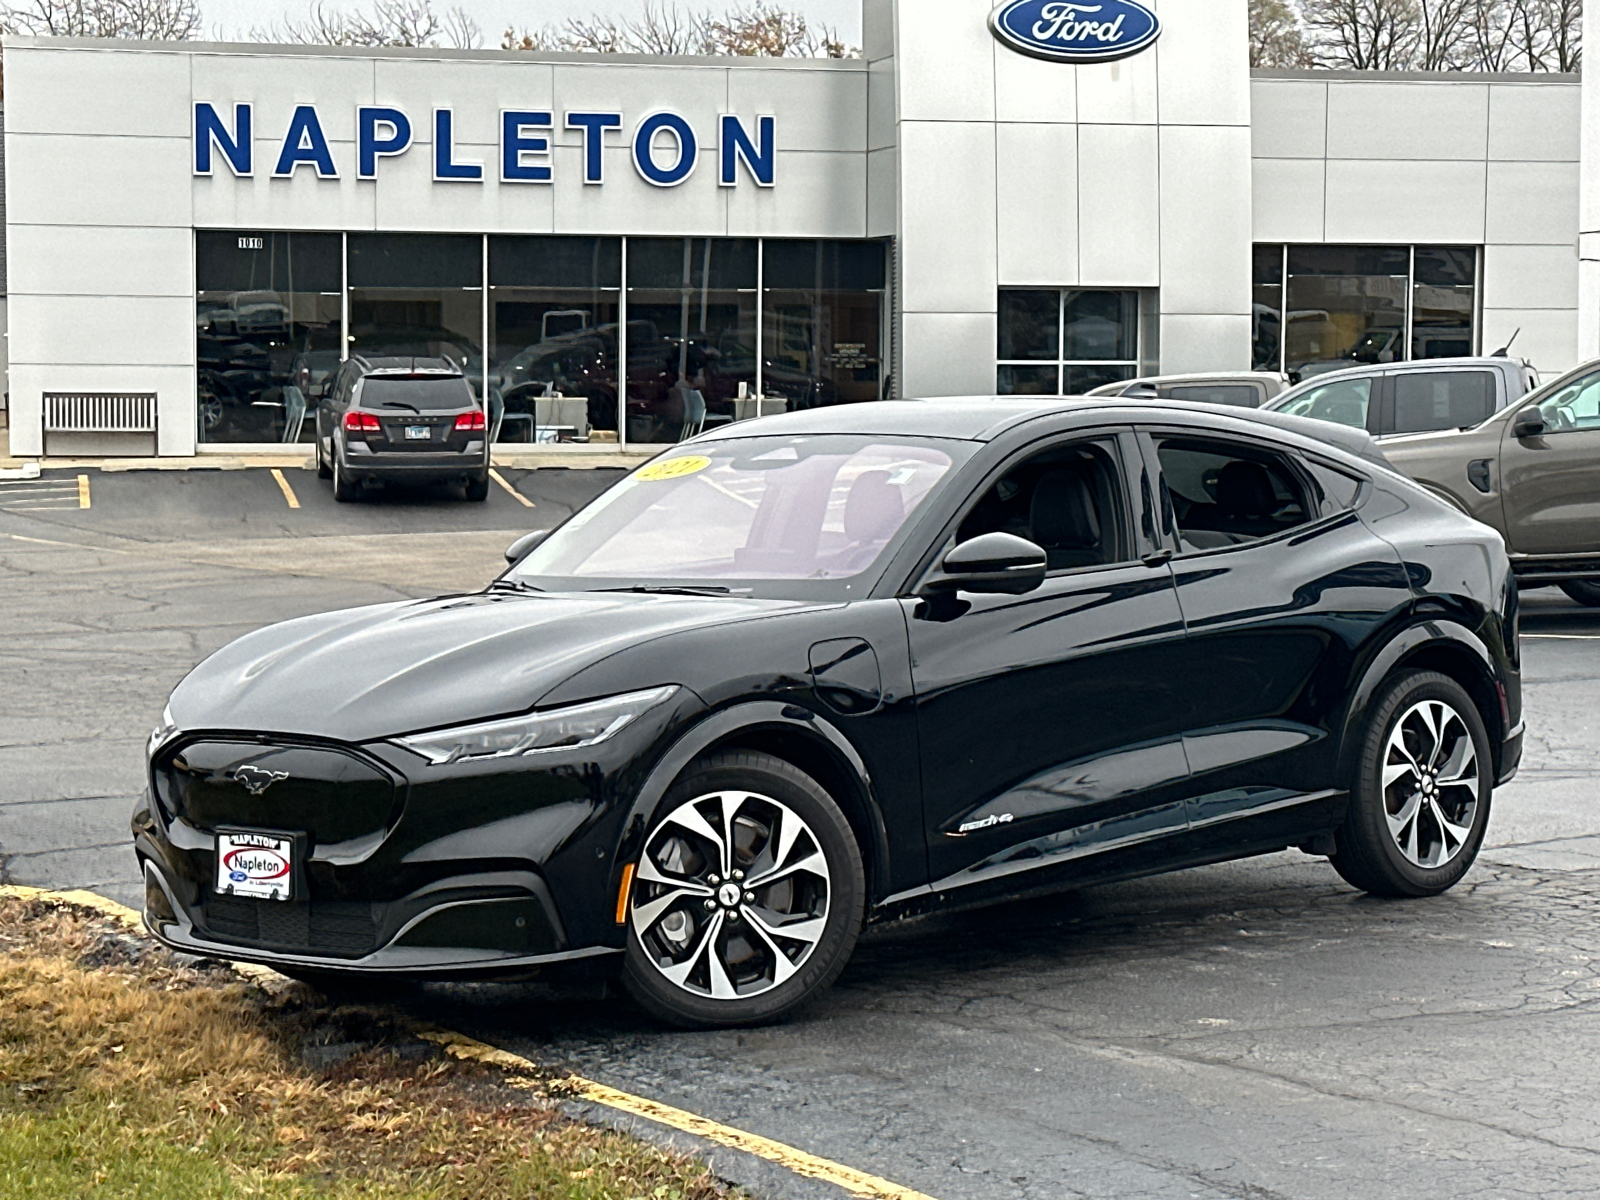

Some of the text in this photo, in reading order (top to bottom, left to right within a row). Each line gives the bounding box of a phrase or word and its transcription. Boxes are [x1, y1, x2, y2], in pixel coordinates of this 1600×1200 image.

[1032, 2, 1125, 42] Ford
[193, 101, 777, 188] NAPLETON
[238, 237, 262, 248] 1010
[234, 854, 279, 873] Napleton
